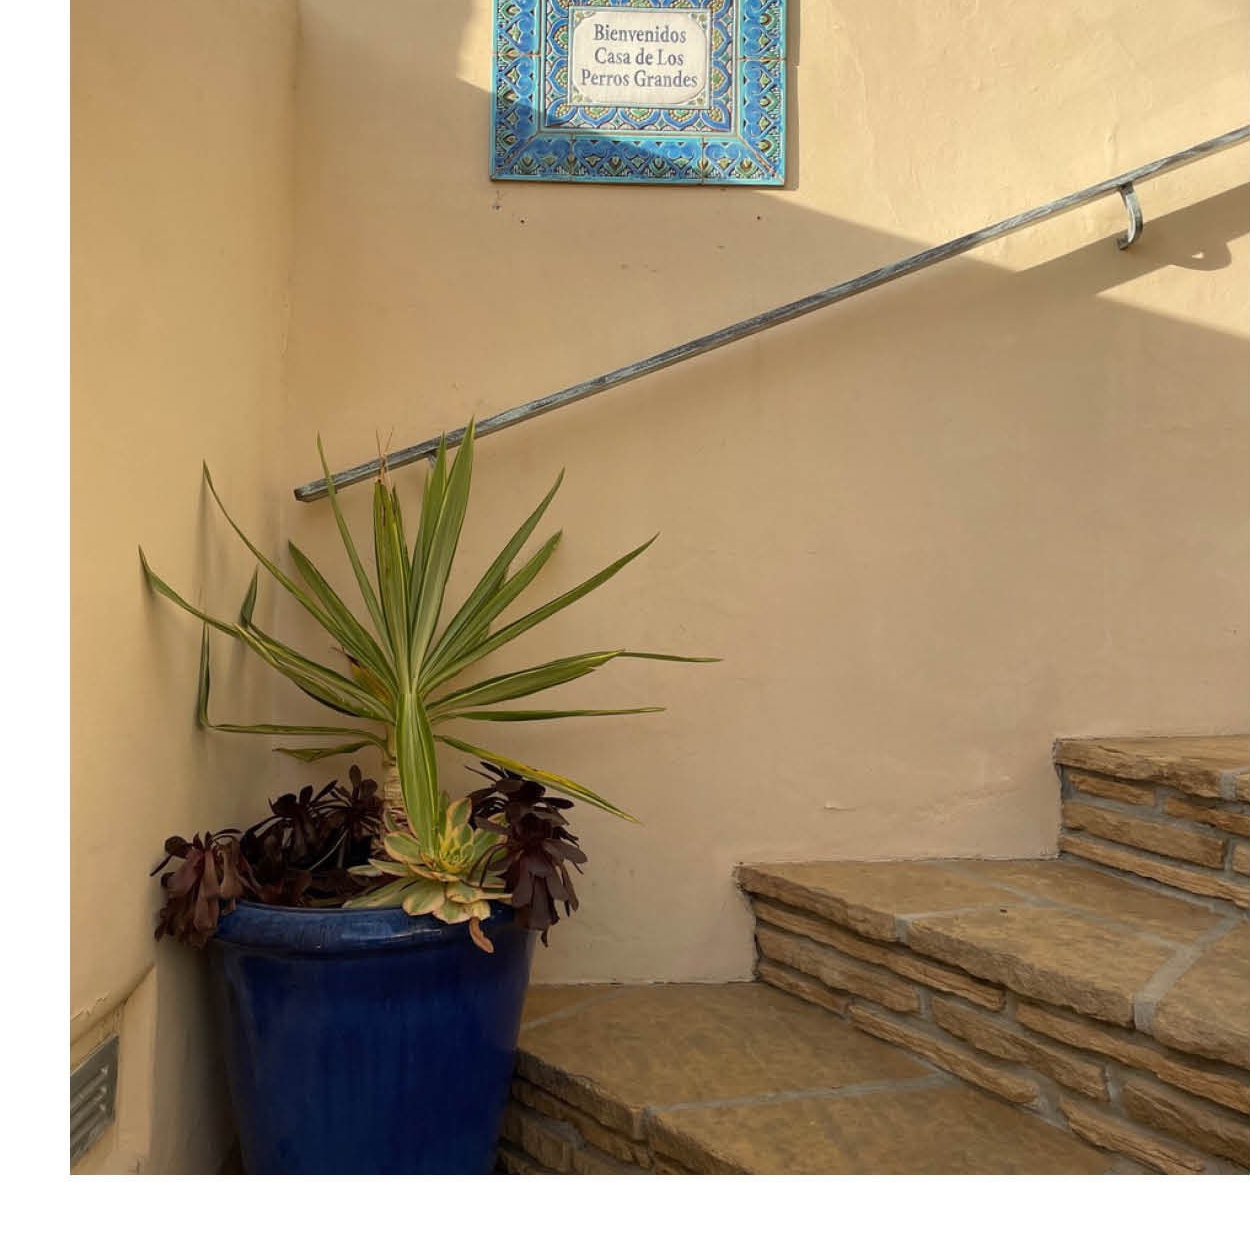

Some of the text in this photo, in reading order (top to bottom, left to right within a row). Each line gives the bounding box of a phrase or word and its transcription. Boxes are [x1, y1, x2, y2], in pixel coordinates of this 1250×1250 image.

[594, 23, 687, 44] Bienvenidos
[594, 47, 684, 66] Casa de Los
[582, 69, 698, 88] Perros Grandes
